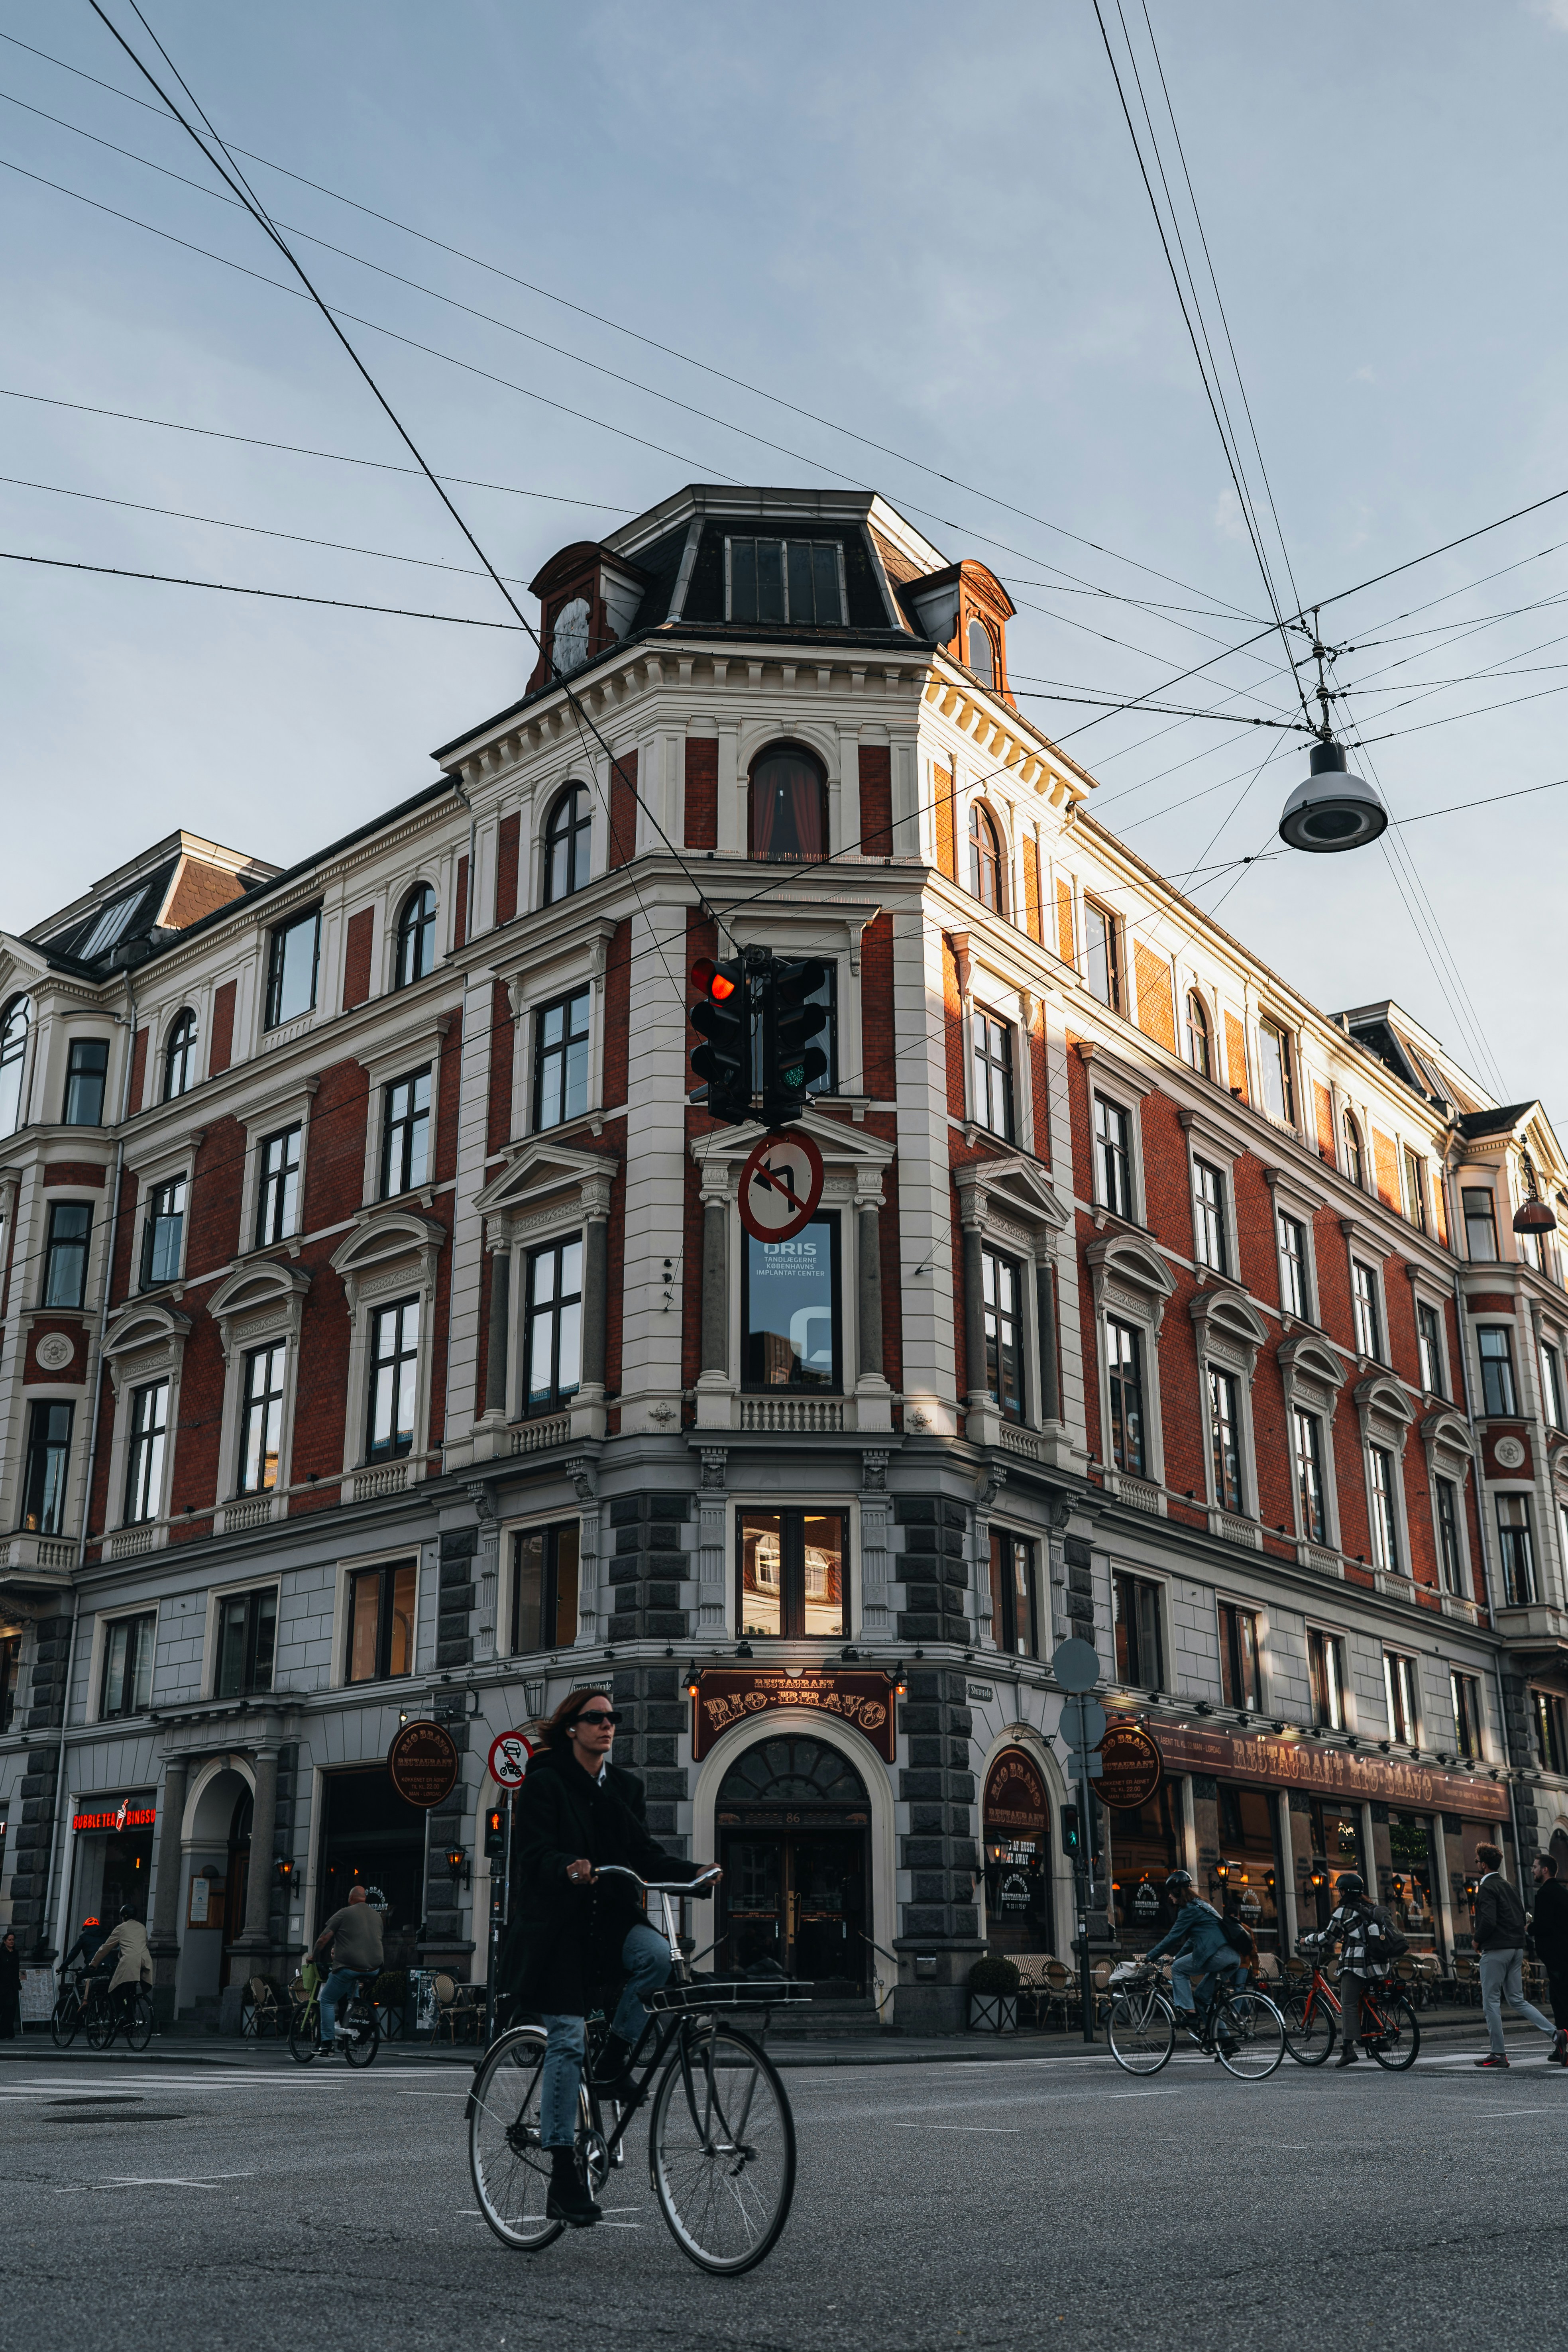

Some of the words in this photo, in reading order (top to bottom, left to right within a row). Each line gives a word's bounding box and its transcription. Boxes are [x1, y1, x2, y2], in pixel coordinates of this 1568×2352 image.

[764, 1242, 817, 1255] ORIS
[1006, 1397, 1017, 1406] ORIS
[754, 1678, 835, 1689] RESTAURANT
[703, 1692, 768, 1731] RIO
[777, 1690, 886, 1730] BRAVO
[401, 1733, 418, 1754] RIO
[419, 1729, 450, 1755] BRAVO
[1117, 1734, 1151, 1757] BRAVO
[1160, 1735, 1173, 1746] ÅBENT
[1193, 1742, 1203, 1751] MAN
[1205, 1745, 1221, 1754] LØRDAG
[397, 1758, 453, 1767] RESTAURANT
[1102, 1760, 1155, 1771] ESTAURANT
[1232, 1738, 1344, 1786] RESTAURANT
[1384, 1765, 1432, 1802] BRAVO
[991, 1766, 1008, 1801] RIO
[1009, 1762, 1041, 1807] BRAVO
[73, 1815, 100, 1829] BUBBLE
[102, 1812, 116, 1827] TEA
[126, 1808, 156, 1826] BINGSU
[786, 1813, 800, 1823] 86
[988, 1808, 1044, 1827] RESTAURANT
[1013, 1840, 1019, 1851] AF
[1020, 1841, 1036, 1853] HUSET
[1015, 1853, 1028, 1865] AWAY
[1004, 1875, 1012, 1891] RIO
[1012, 1874, 1028, 1892] BRAVO
[369, 1886, 385, 1903] BRAVO
[1002, 1892, 1031, 1901] RESTAURANT
